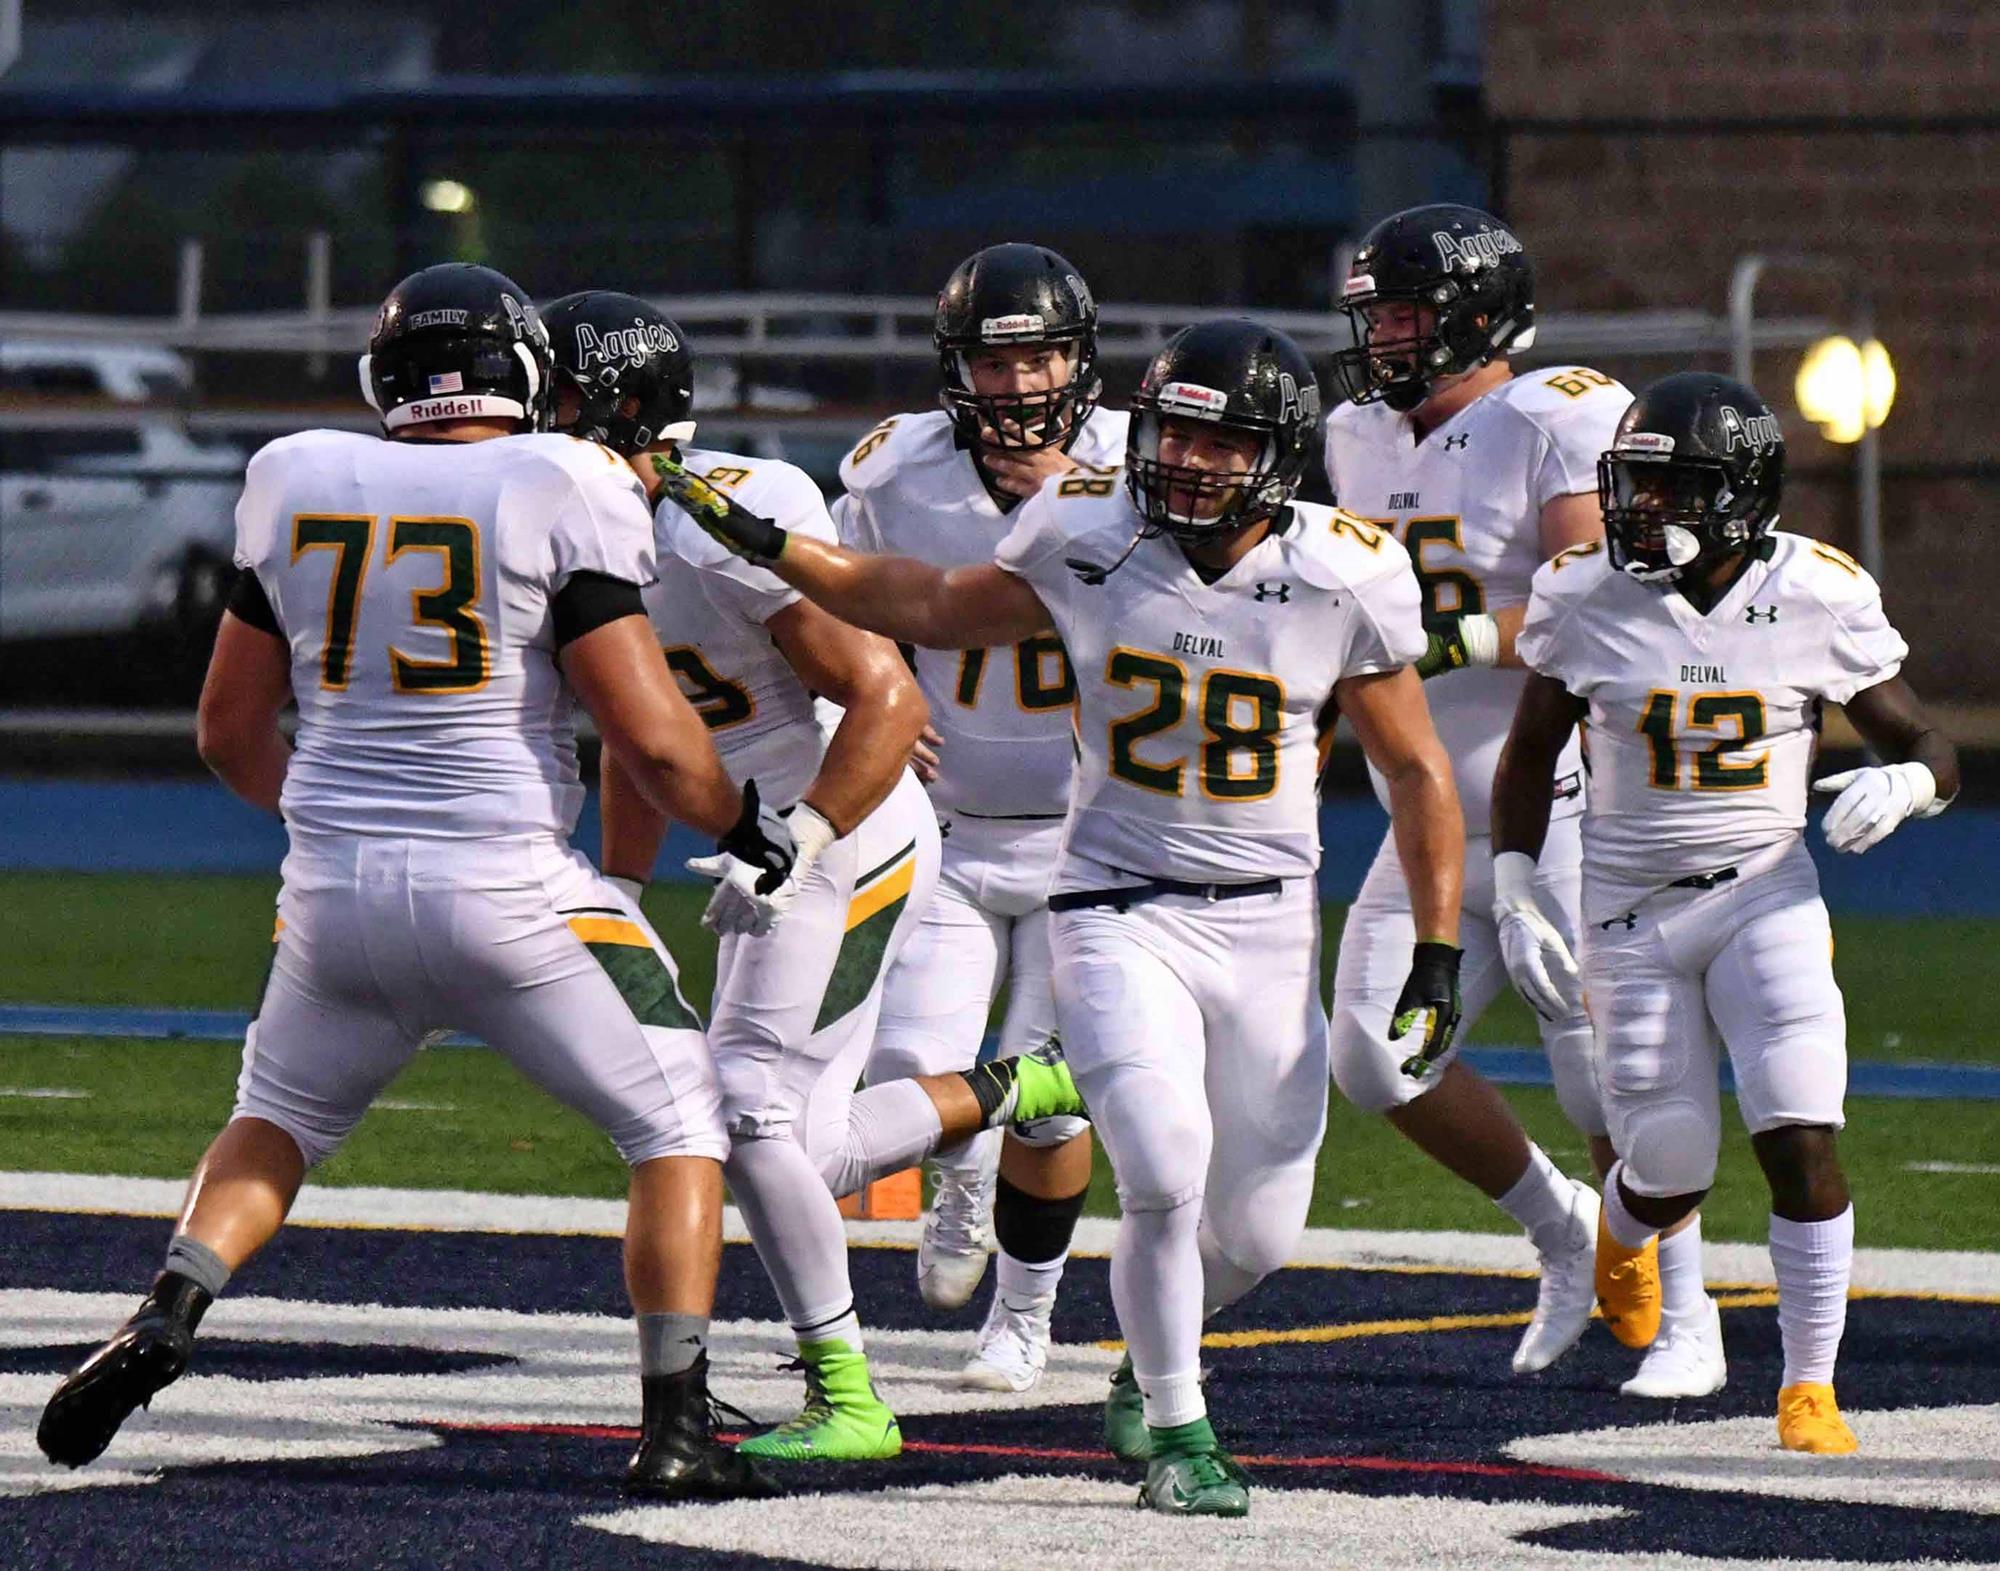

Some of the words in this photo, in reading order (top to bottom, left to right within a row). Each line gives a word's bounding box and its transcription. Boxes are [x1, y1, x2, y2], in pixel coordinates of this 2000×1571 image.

[410, 308, 468, 330] FAMILY
[576, 317, 679, 370] Aggies
[410, 398, 484, 419] Riddell
[1387, 491, 1420, 510] DELVAL
[1328, 507, 1386, 554] 2
[1366, 513, 1487, 632] 6
[290, 512, 491, 695] 73
[1173, 631, 1226, 660] DELVAL
[1680, 664, 1727, 684] DELVAL
[1104, 645, 1287, 803] 28
[1636, 688, 1771, 793] 12
